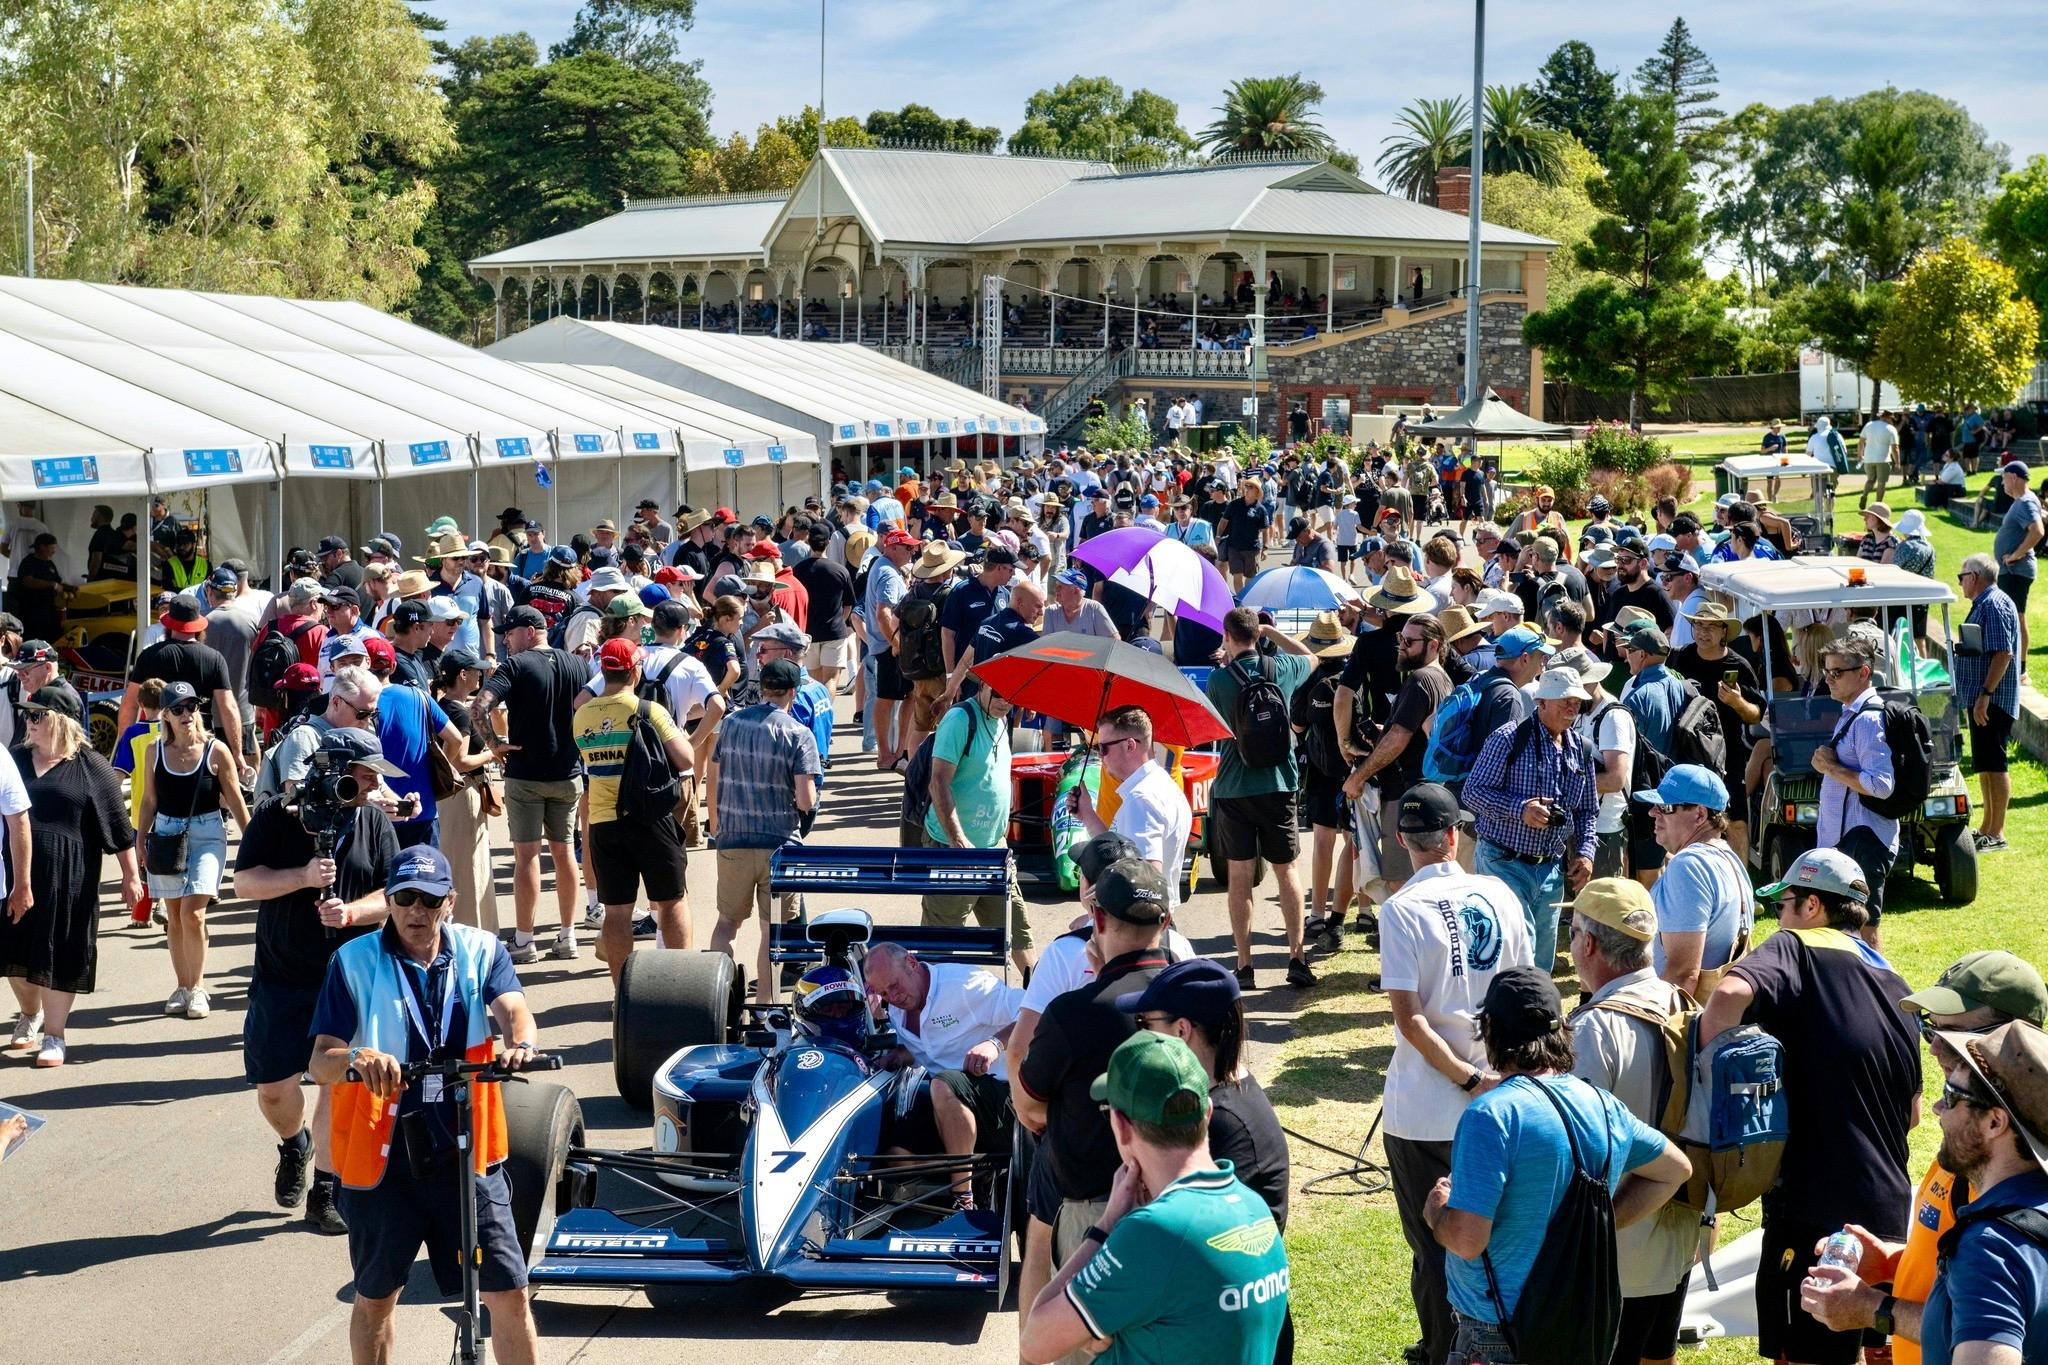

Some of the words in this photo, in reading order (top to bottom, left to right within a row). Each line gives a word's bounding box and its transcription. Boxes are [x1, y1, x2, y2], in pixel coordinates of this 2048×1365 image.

[1192, 778, 1213, 811] RI
[784, 866, 859, 877] PIRELLI
[929, 869, 1004, 879] PIRELLI
[824, 981, 847, 991] ROWE
[769, 1151, 806, 1173] 7
[555, 1234, 668, 1247] PIRELLI
[888, 1237, 1001, 1252] PIRELLI
